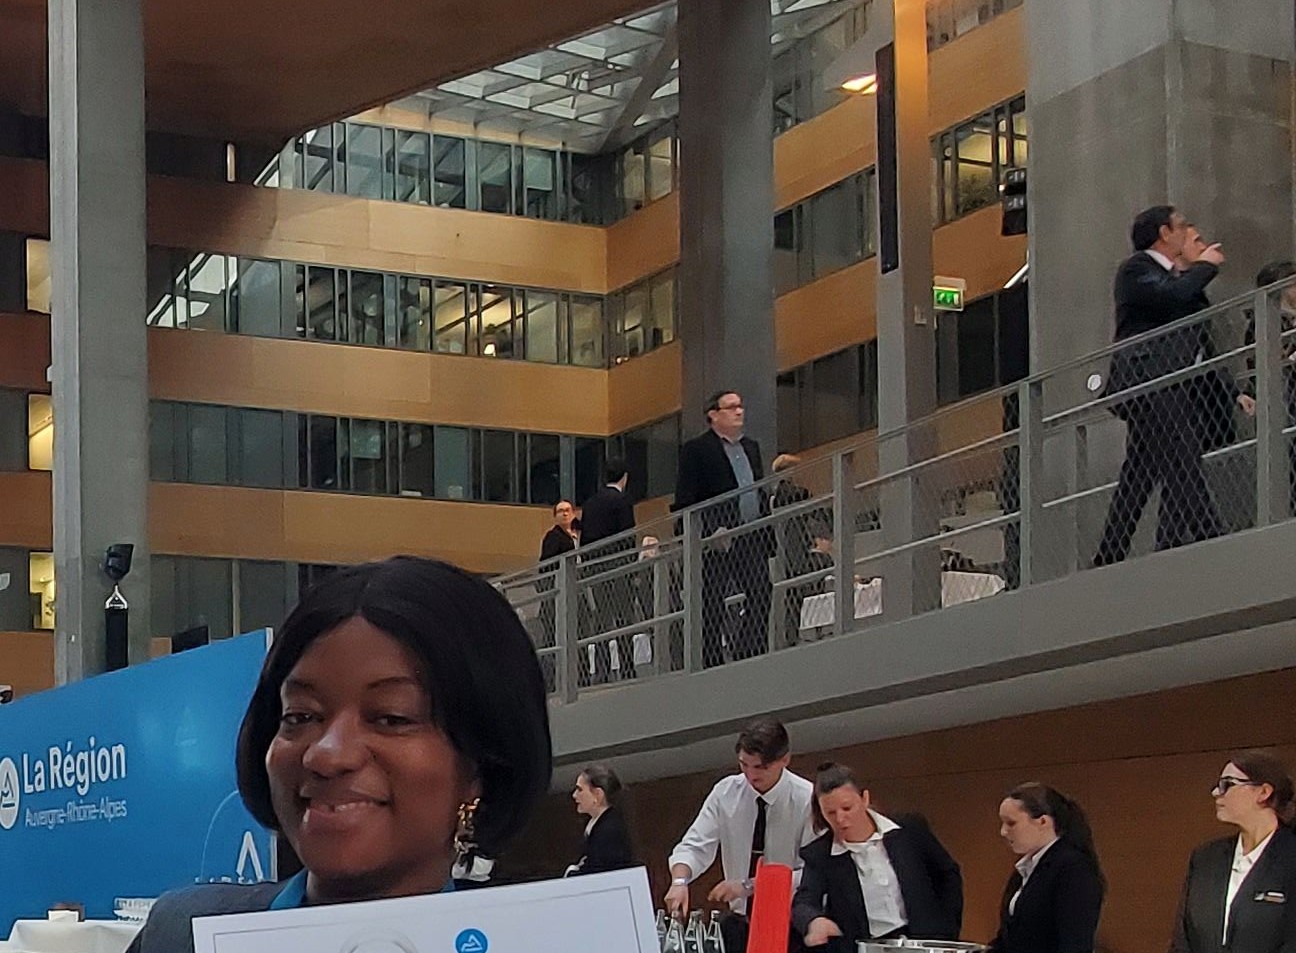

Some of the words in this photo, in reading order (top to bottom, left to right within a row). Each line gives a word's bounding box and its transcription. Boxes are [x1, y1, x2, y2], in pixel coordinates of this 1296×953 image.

[22, 753, 45, 794] La
[49, 736, 126, 796] Région
[25, 797, 128, 829] Auvergne-Rhône-Alpes
